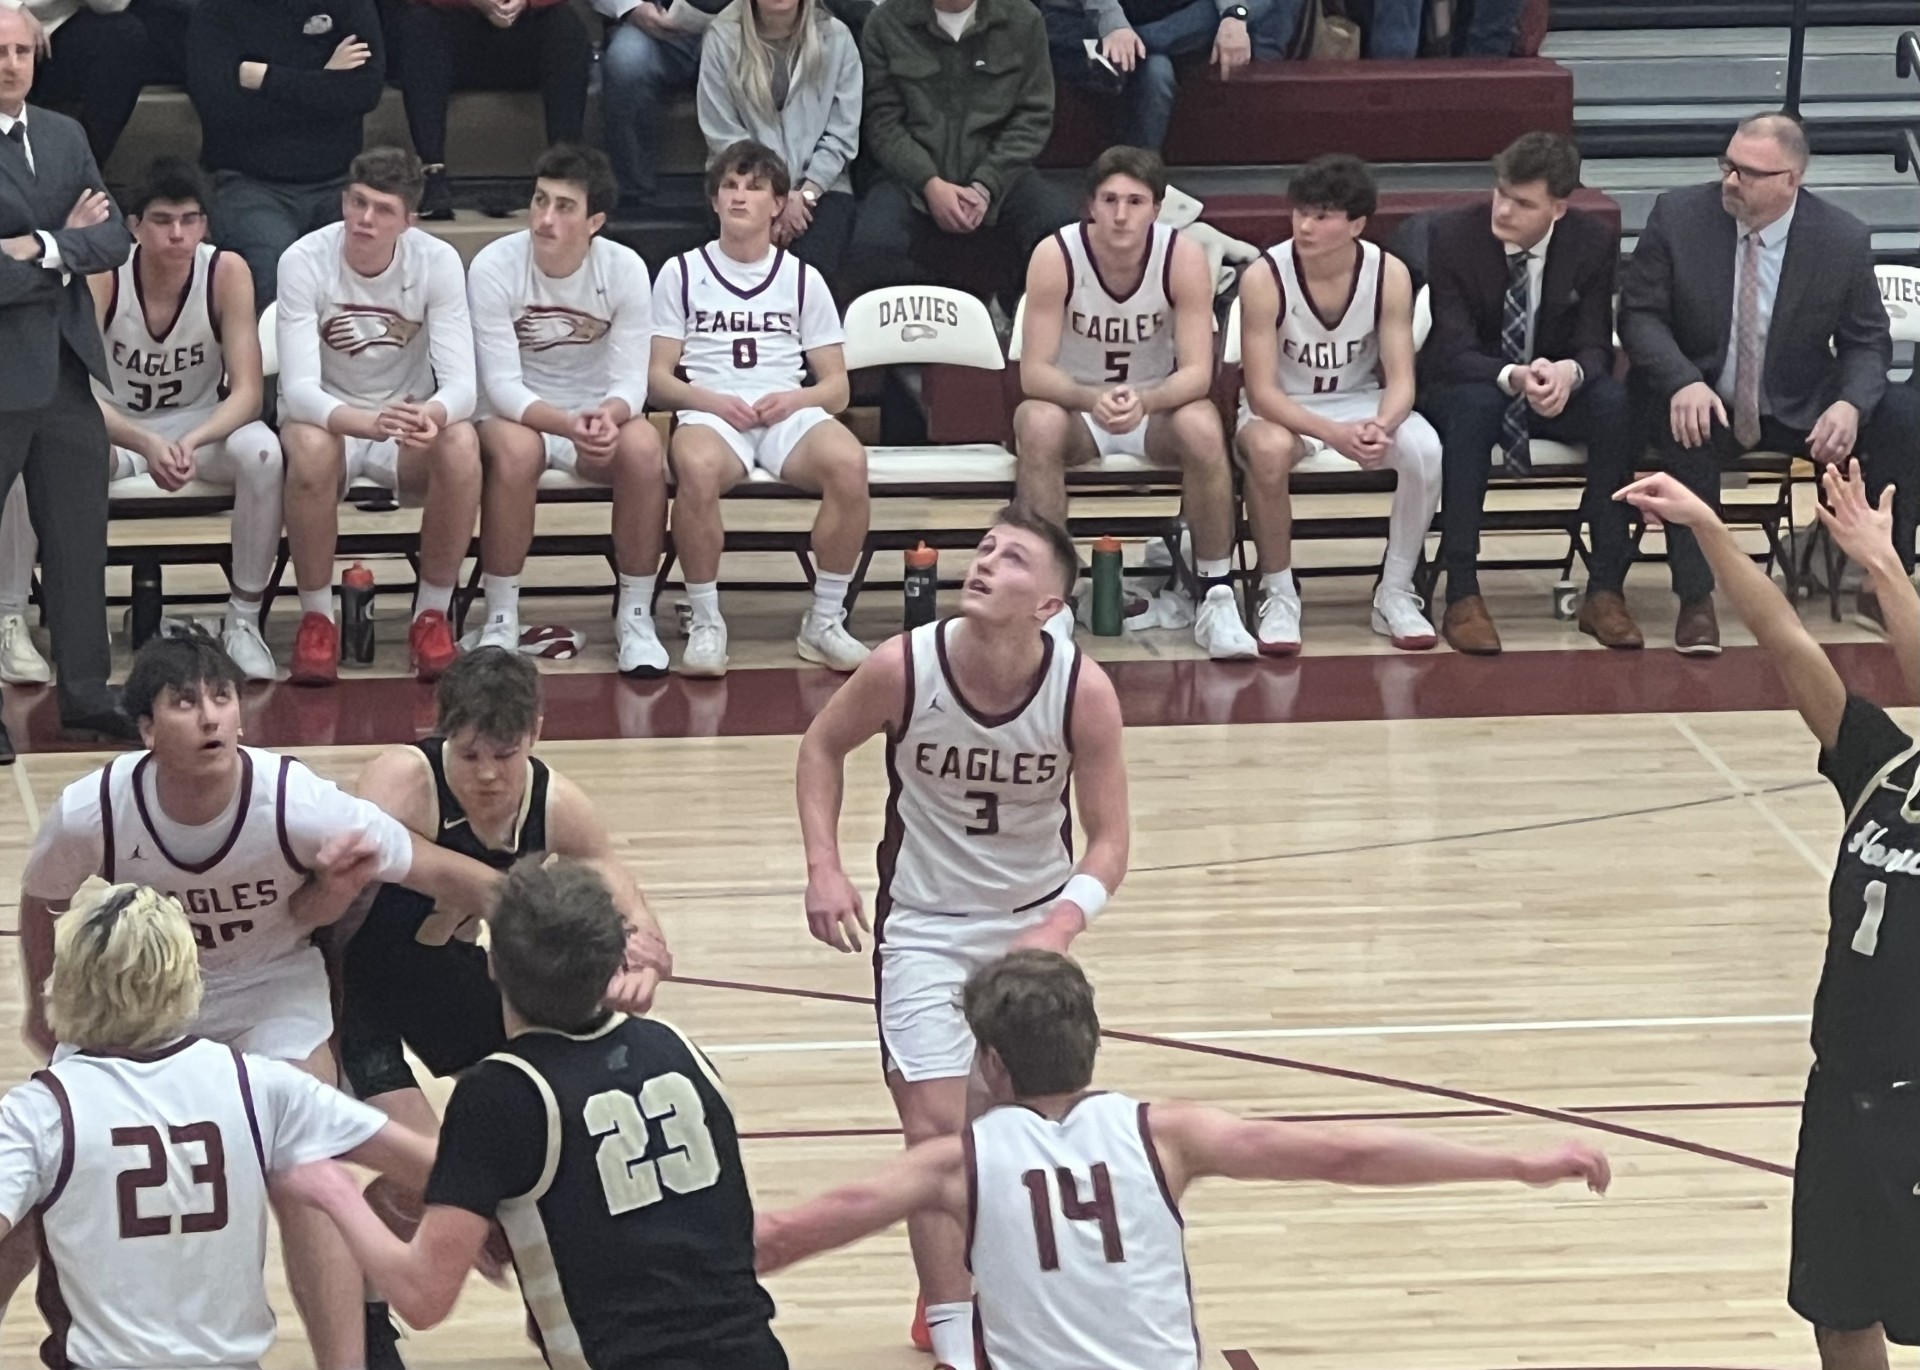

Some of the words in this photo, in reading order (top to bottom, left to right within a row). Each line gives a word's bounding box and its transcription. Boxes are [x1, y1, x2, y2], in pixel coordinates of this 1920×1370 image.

[1877, 276, 1920, 306] VIES
[695, 310, 792, 334] EAGLES
[879, 296, 958, 327] DAVIES
[112, 340, 204, 376] EAGLES
[1104, 351, 1131, 382] 5
[1283, 339, 1366, 369] EAGLE
[127, 380, 183, 411] 32
[915, 742, 1058, 784] EAGLES
[965, 790, 998, 835] 3
[166, 879, 278, 913] GLES
[1851, 880, 1887, 956] 1
[583, 1071, 721, 1216] 23
[110, 1121, 228, 1239] 23
[1021, 1161, 1126, 1272] 14
